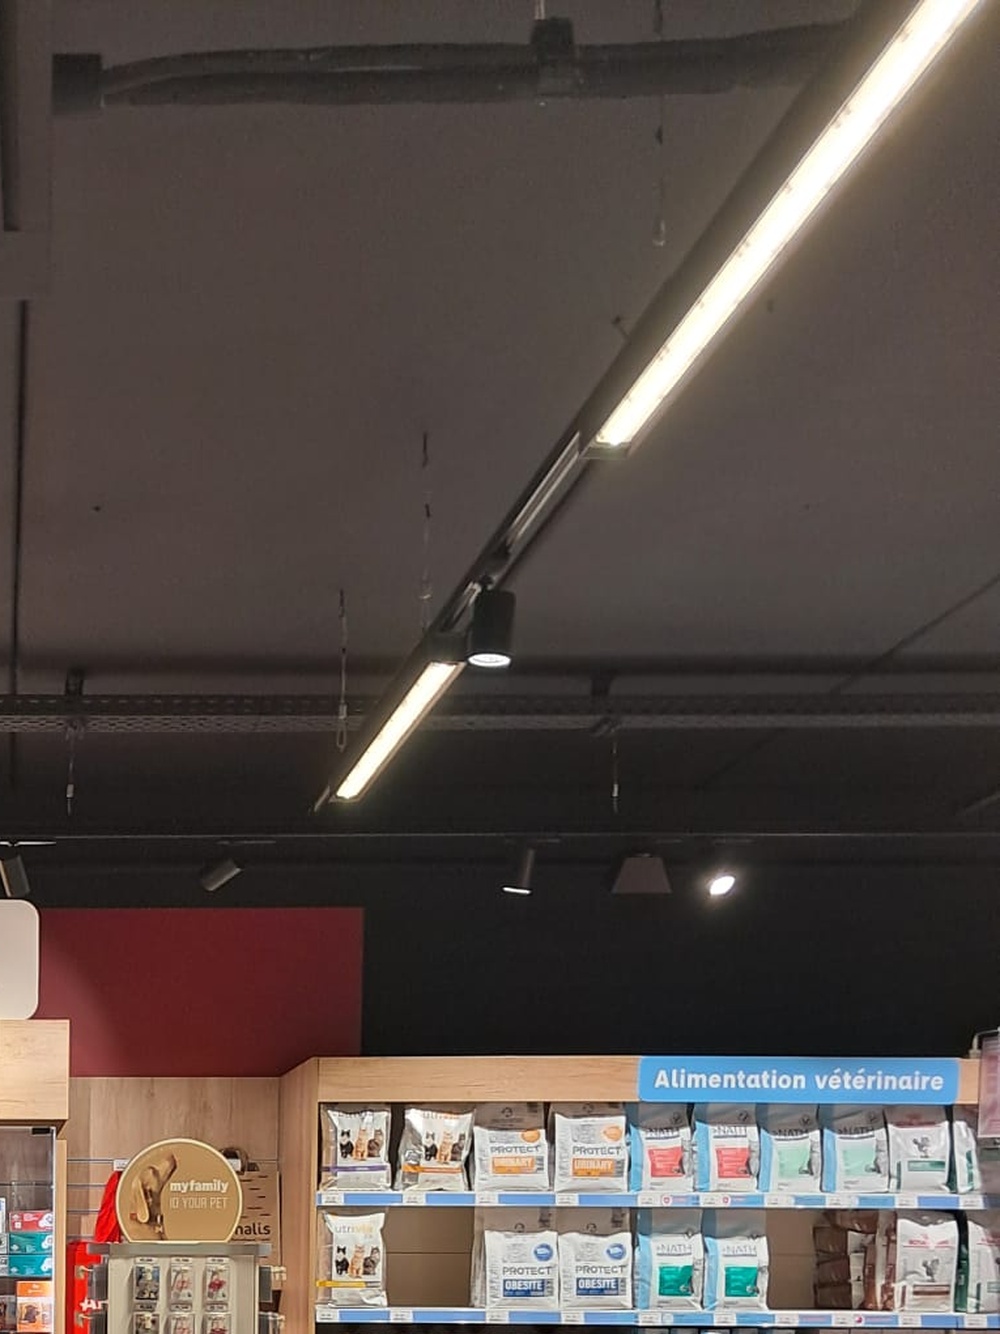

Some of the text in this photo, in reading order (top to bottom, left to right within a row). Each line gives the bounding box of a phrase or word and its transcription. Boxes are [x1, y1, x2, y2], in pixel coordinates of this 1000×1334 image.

[654, 1067, 944, 1091] Alimentation vétérinaire
[490, 1145, 541, 1154] PROTECT
[572, 1145, 622, 1155] PROTECT
[183, 1197, 208, 1209] YOUR
[209, 1196, 229, 1209] PET
[502, 1266, 552, 1275] PROTECT
[575, 1265, 626, 1275] PROTECT
